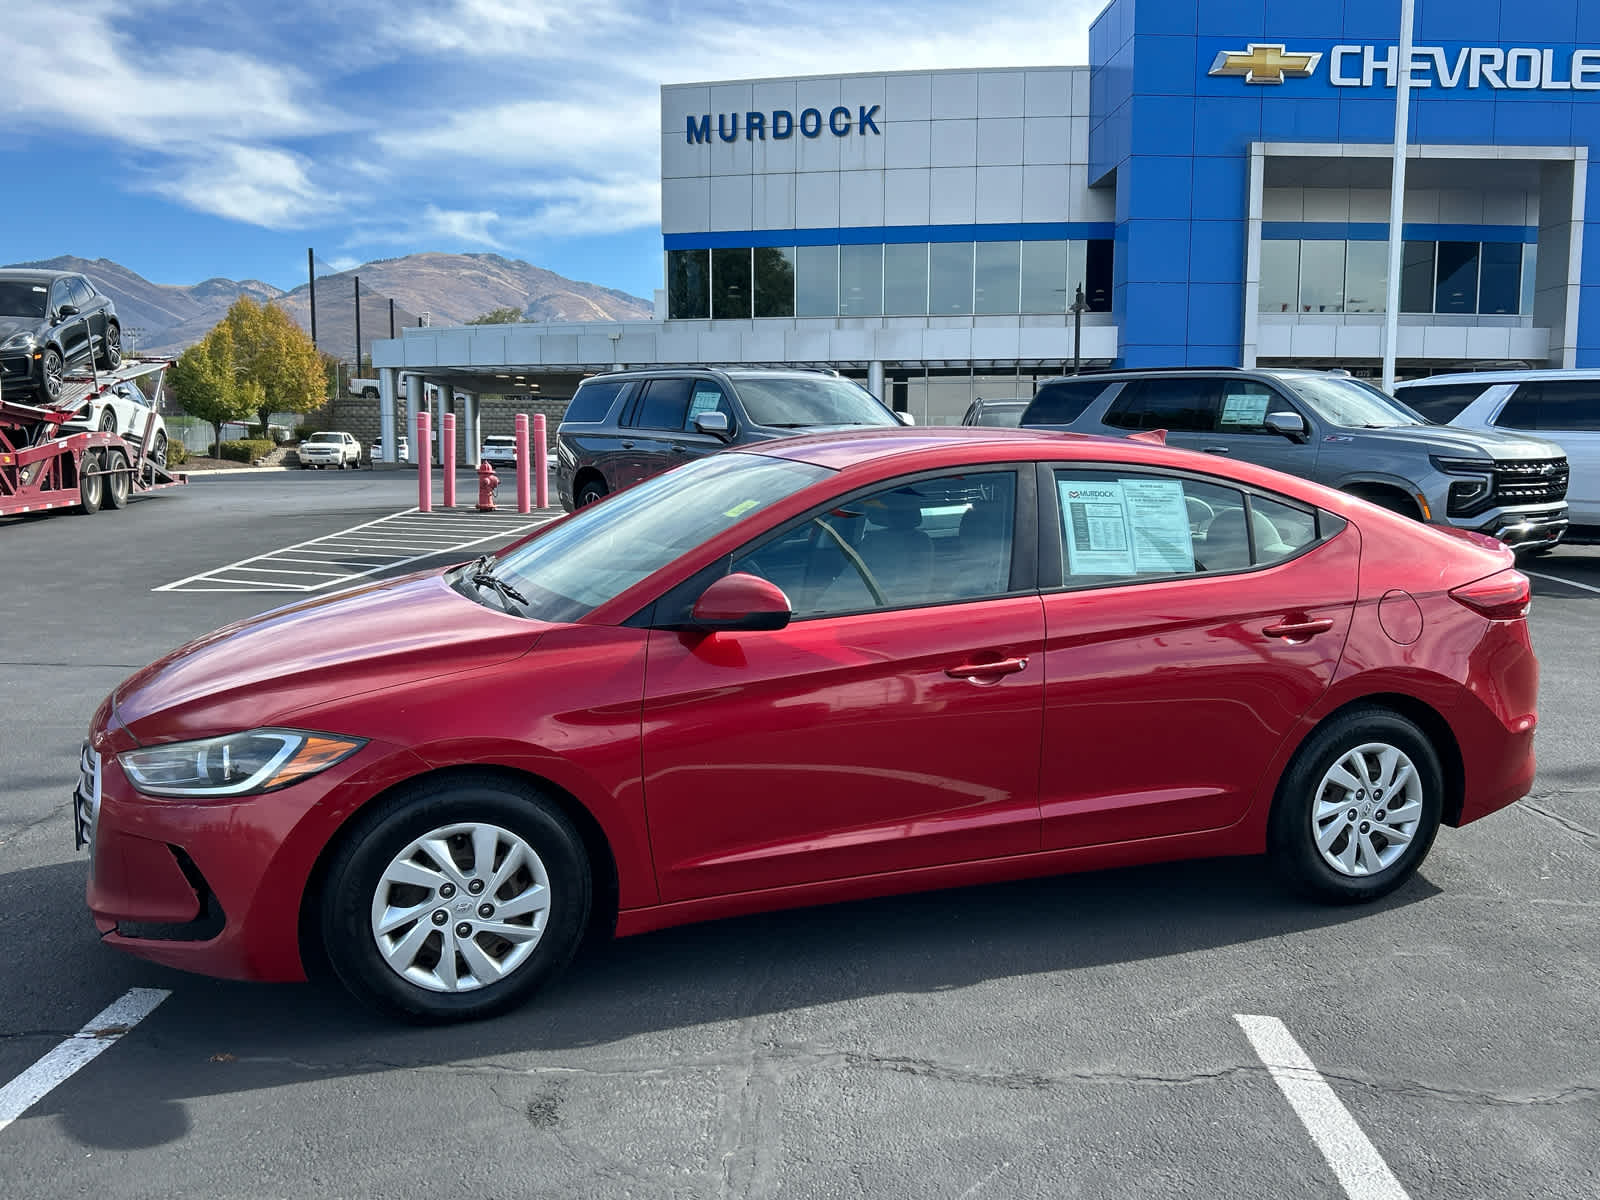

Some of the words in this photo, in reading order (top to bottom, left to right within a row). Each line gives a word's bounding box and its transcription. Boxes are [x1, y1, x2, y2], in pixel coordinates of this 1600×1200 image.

[1330, 45, 1600, 89] CHEVROLE
[686, 105, 881, 144] MURDOCK
[1080, 490, 1114, 498] MURDOCK
